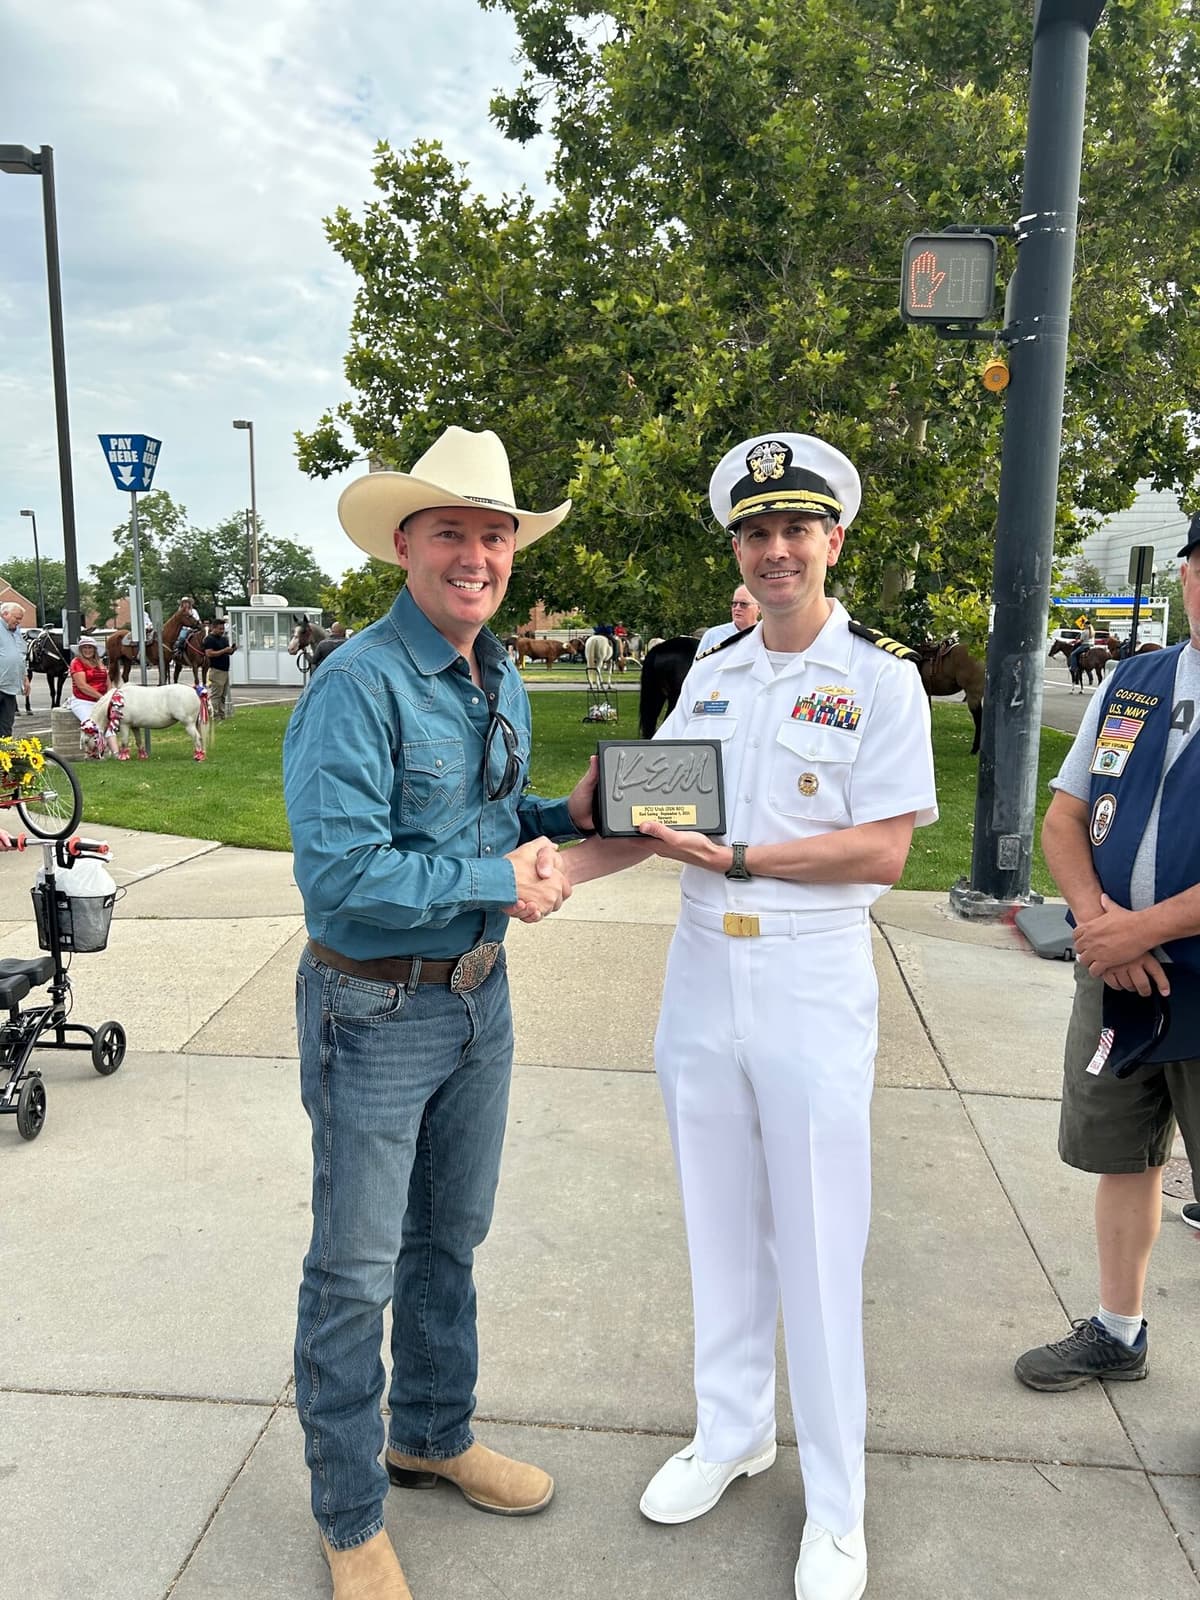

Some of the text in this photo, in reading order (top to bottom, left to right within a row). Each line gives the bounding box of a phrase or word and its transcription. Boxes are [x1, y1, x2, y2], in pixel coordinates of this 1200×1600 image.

[110, 438, 132, 450] PAY
[108, 450, 139, 463] HERE
[1115, 688, 1159, 706] COSTELLO
[1109, 703, 1149, 718] U.S. NAVY
